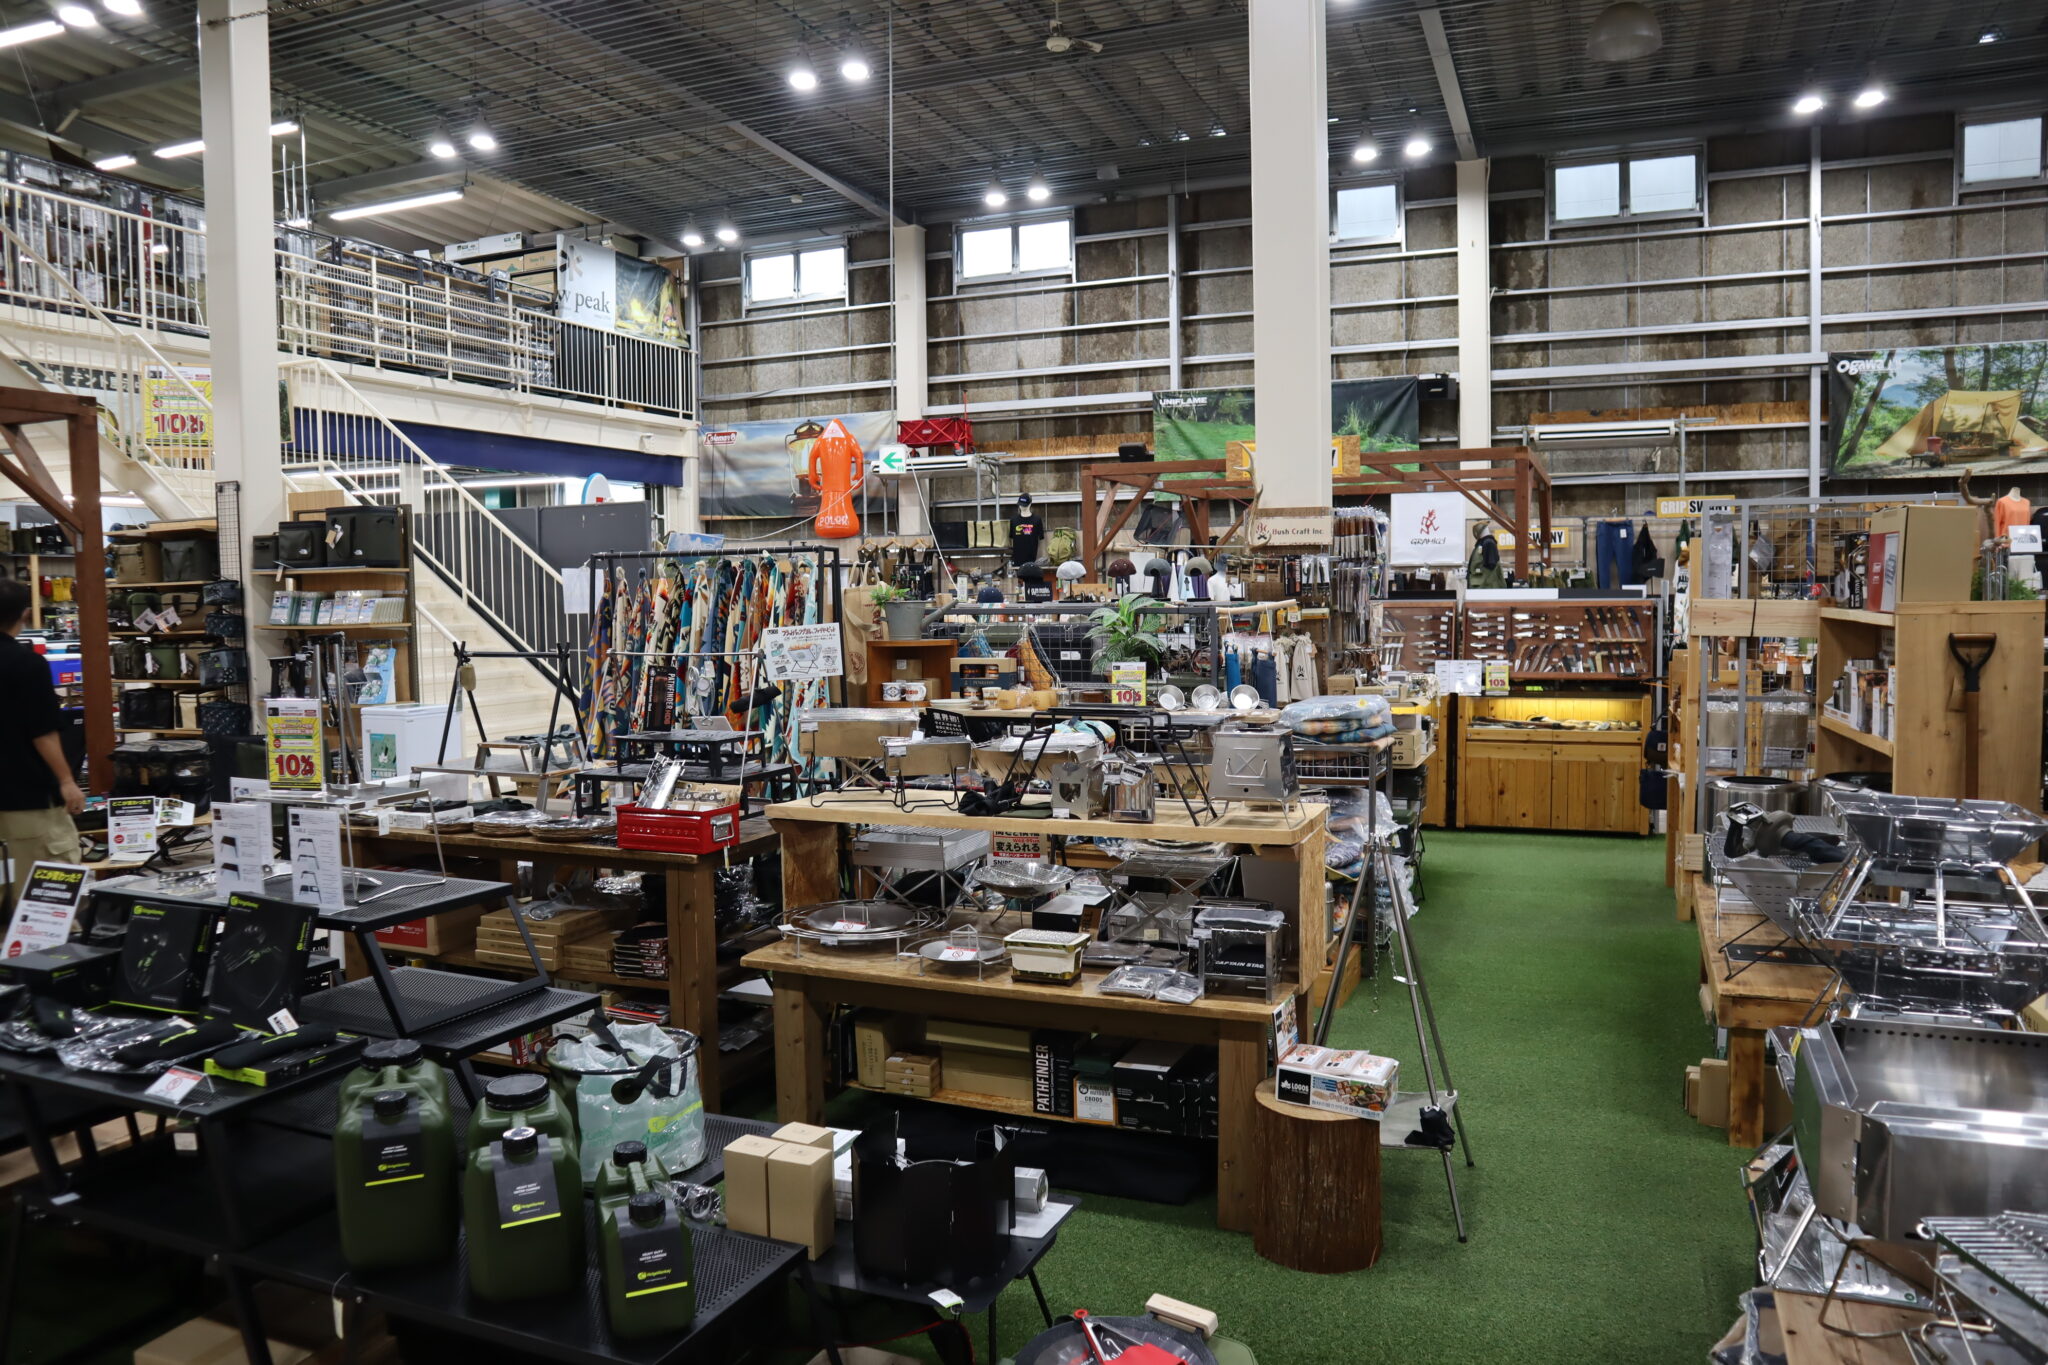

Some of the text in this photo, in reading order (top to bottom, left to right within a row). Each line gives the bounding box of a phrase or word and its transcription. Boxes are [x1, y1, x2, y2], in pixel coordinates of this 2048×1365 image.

[575, 291, 610, 314] peak
[1159, 396, 1208, 406] UNIFLAME
[1660, 500, 1687, 515] GRIP
[1291, 527, 1312, 535] Craft
[1312, 527, 1324, 535] Inc.
[665, 673, 676, 710] PATHFINDER
[995, 841, 1040, 852] 変えられる
[1035, 1045, 1050, 1112] PATHFINDER
[1291, 1083, 1309, 1092] LOGOS
